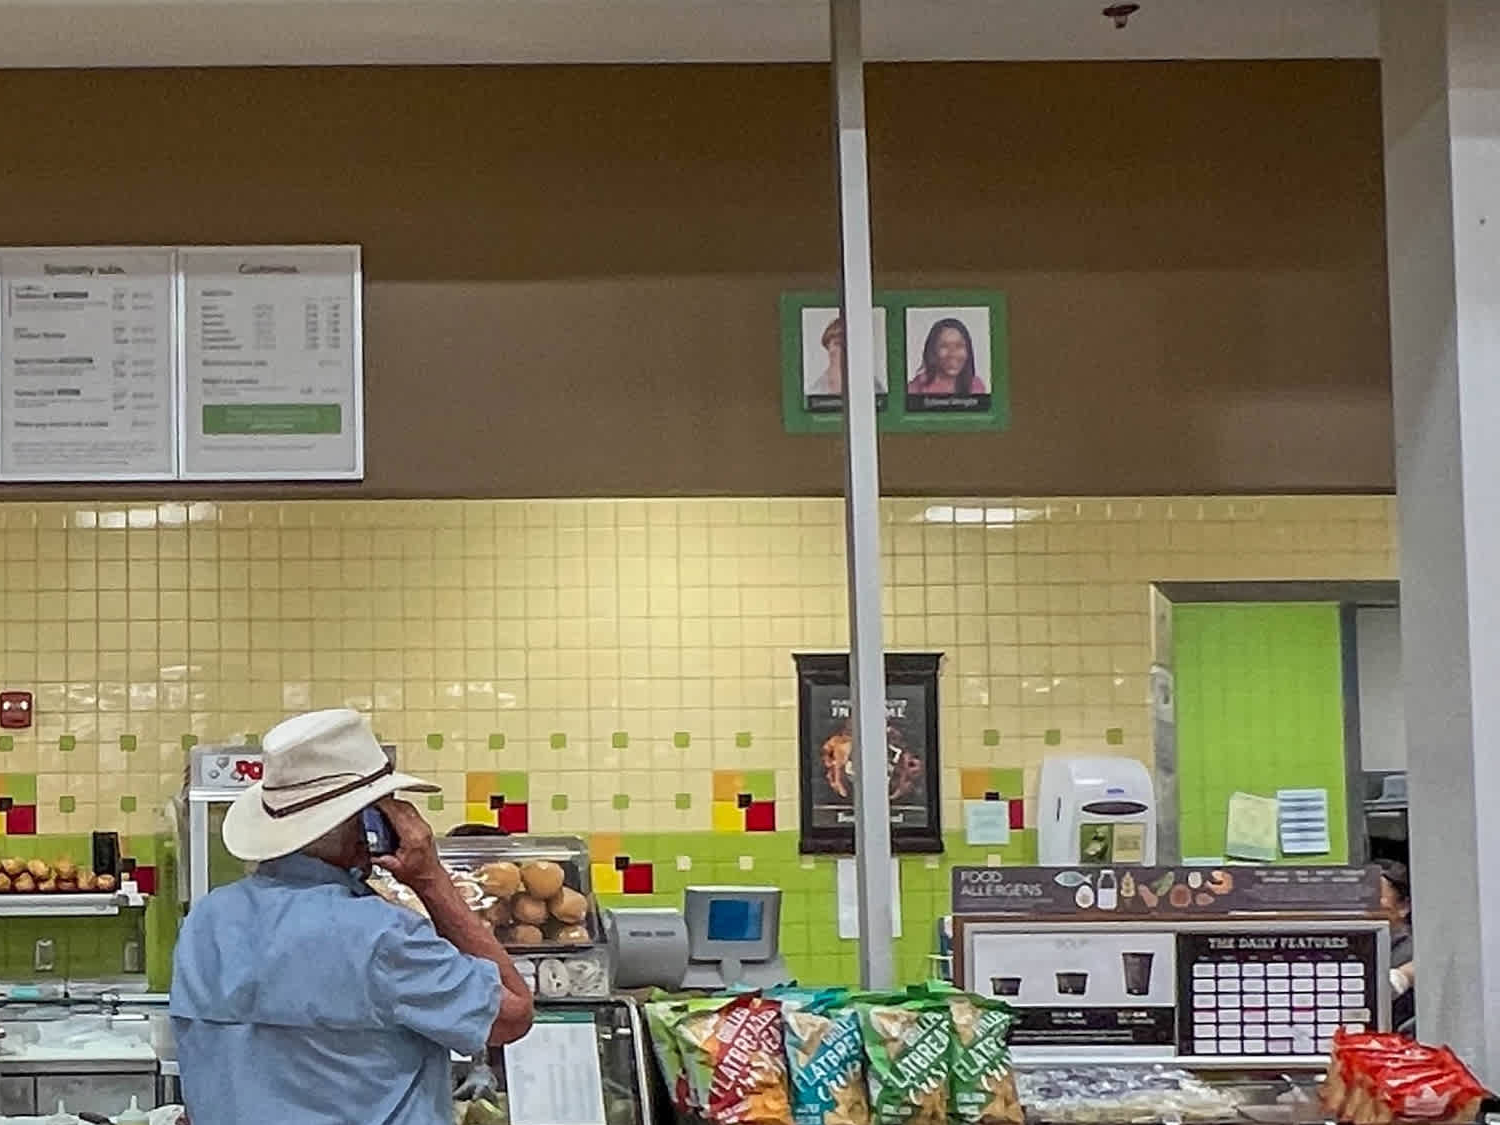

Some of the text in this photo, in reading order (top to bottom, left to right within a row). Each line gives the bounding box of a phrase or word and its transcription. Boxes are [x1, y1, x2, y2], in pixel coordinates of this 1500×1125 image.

[961, 871, 1003, 884] FOOD
[960, 883, 1043, 897] ALLERGENS
[1208, 937, 1349, 950] THE DAILY FEATURES
